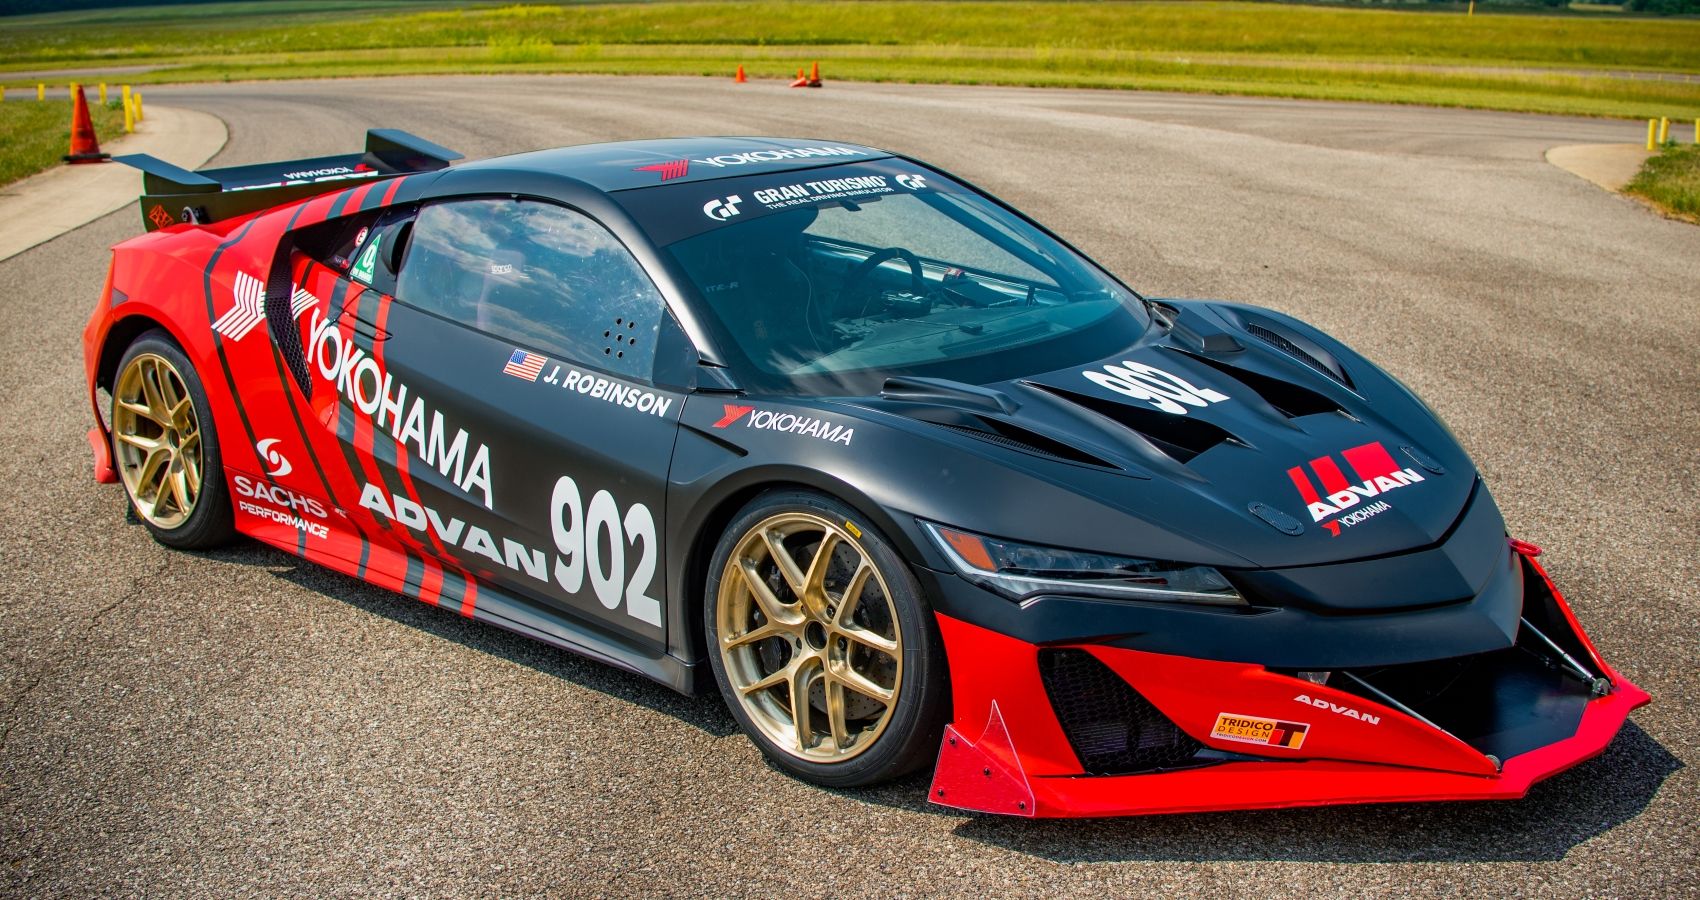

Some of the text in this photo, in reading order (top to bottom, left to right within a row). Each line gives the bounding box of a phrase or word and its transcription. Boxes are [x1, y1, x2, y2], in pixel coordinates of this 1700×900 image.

[284, 166, 354, 180] YOKOHAMA
[692, 147, 868, 167] YOKOHAMA
[753, 175, 887, 205] GRAN TURISMO
[765, 187, 895, 210] THE REAL DRIVING SIMULATOR
[543, 365, 672, 418] J. ROBINSON
[1081, 360, 1231, 415] 902
[306, 307, 494, 511] YOKOHAMA
[746, 409, 855, 446] YOKOHAMA
[234, 475, 328, 519] SACHS
[1306, 467, 1426, 523] ADVAN
[239, 500, 330, 540] PERFORMANCE
[358, 482, 549, 583] ADVAN
[1338, 500, 1392, 528] YOKOHAMA
[549, 475, 663, 629] 902
[1221, 717, 1274, 731] TRIDICO
[1293, 694, 1382, 726] ADVAN
[1217, 725, 1271, 738] DESIGN
